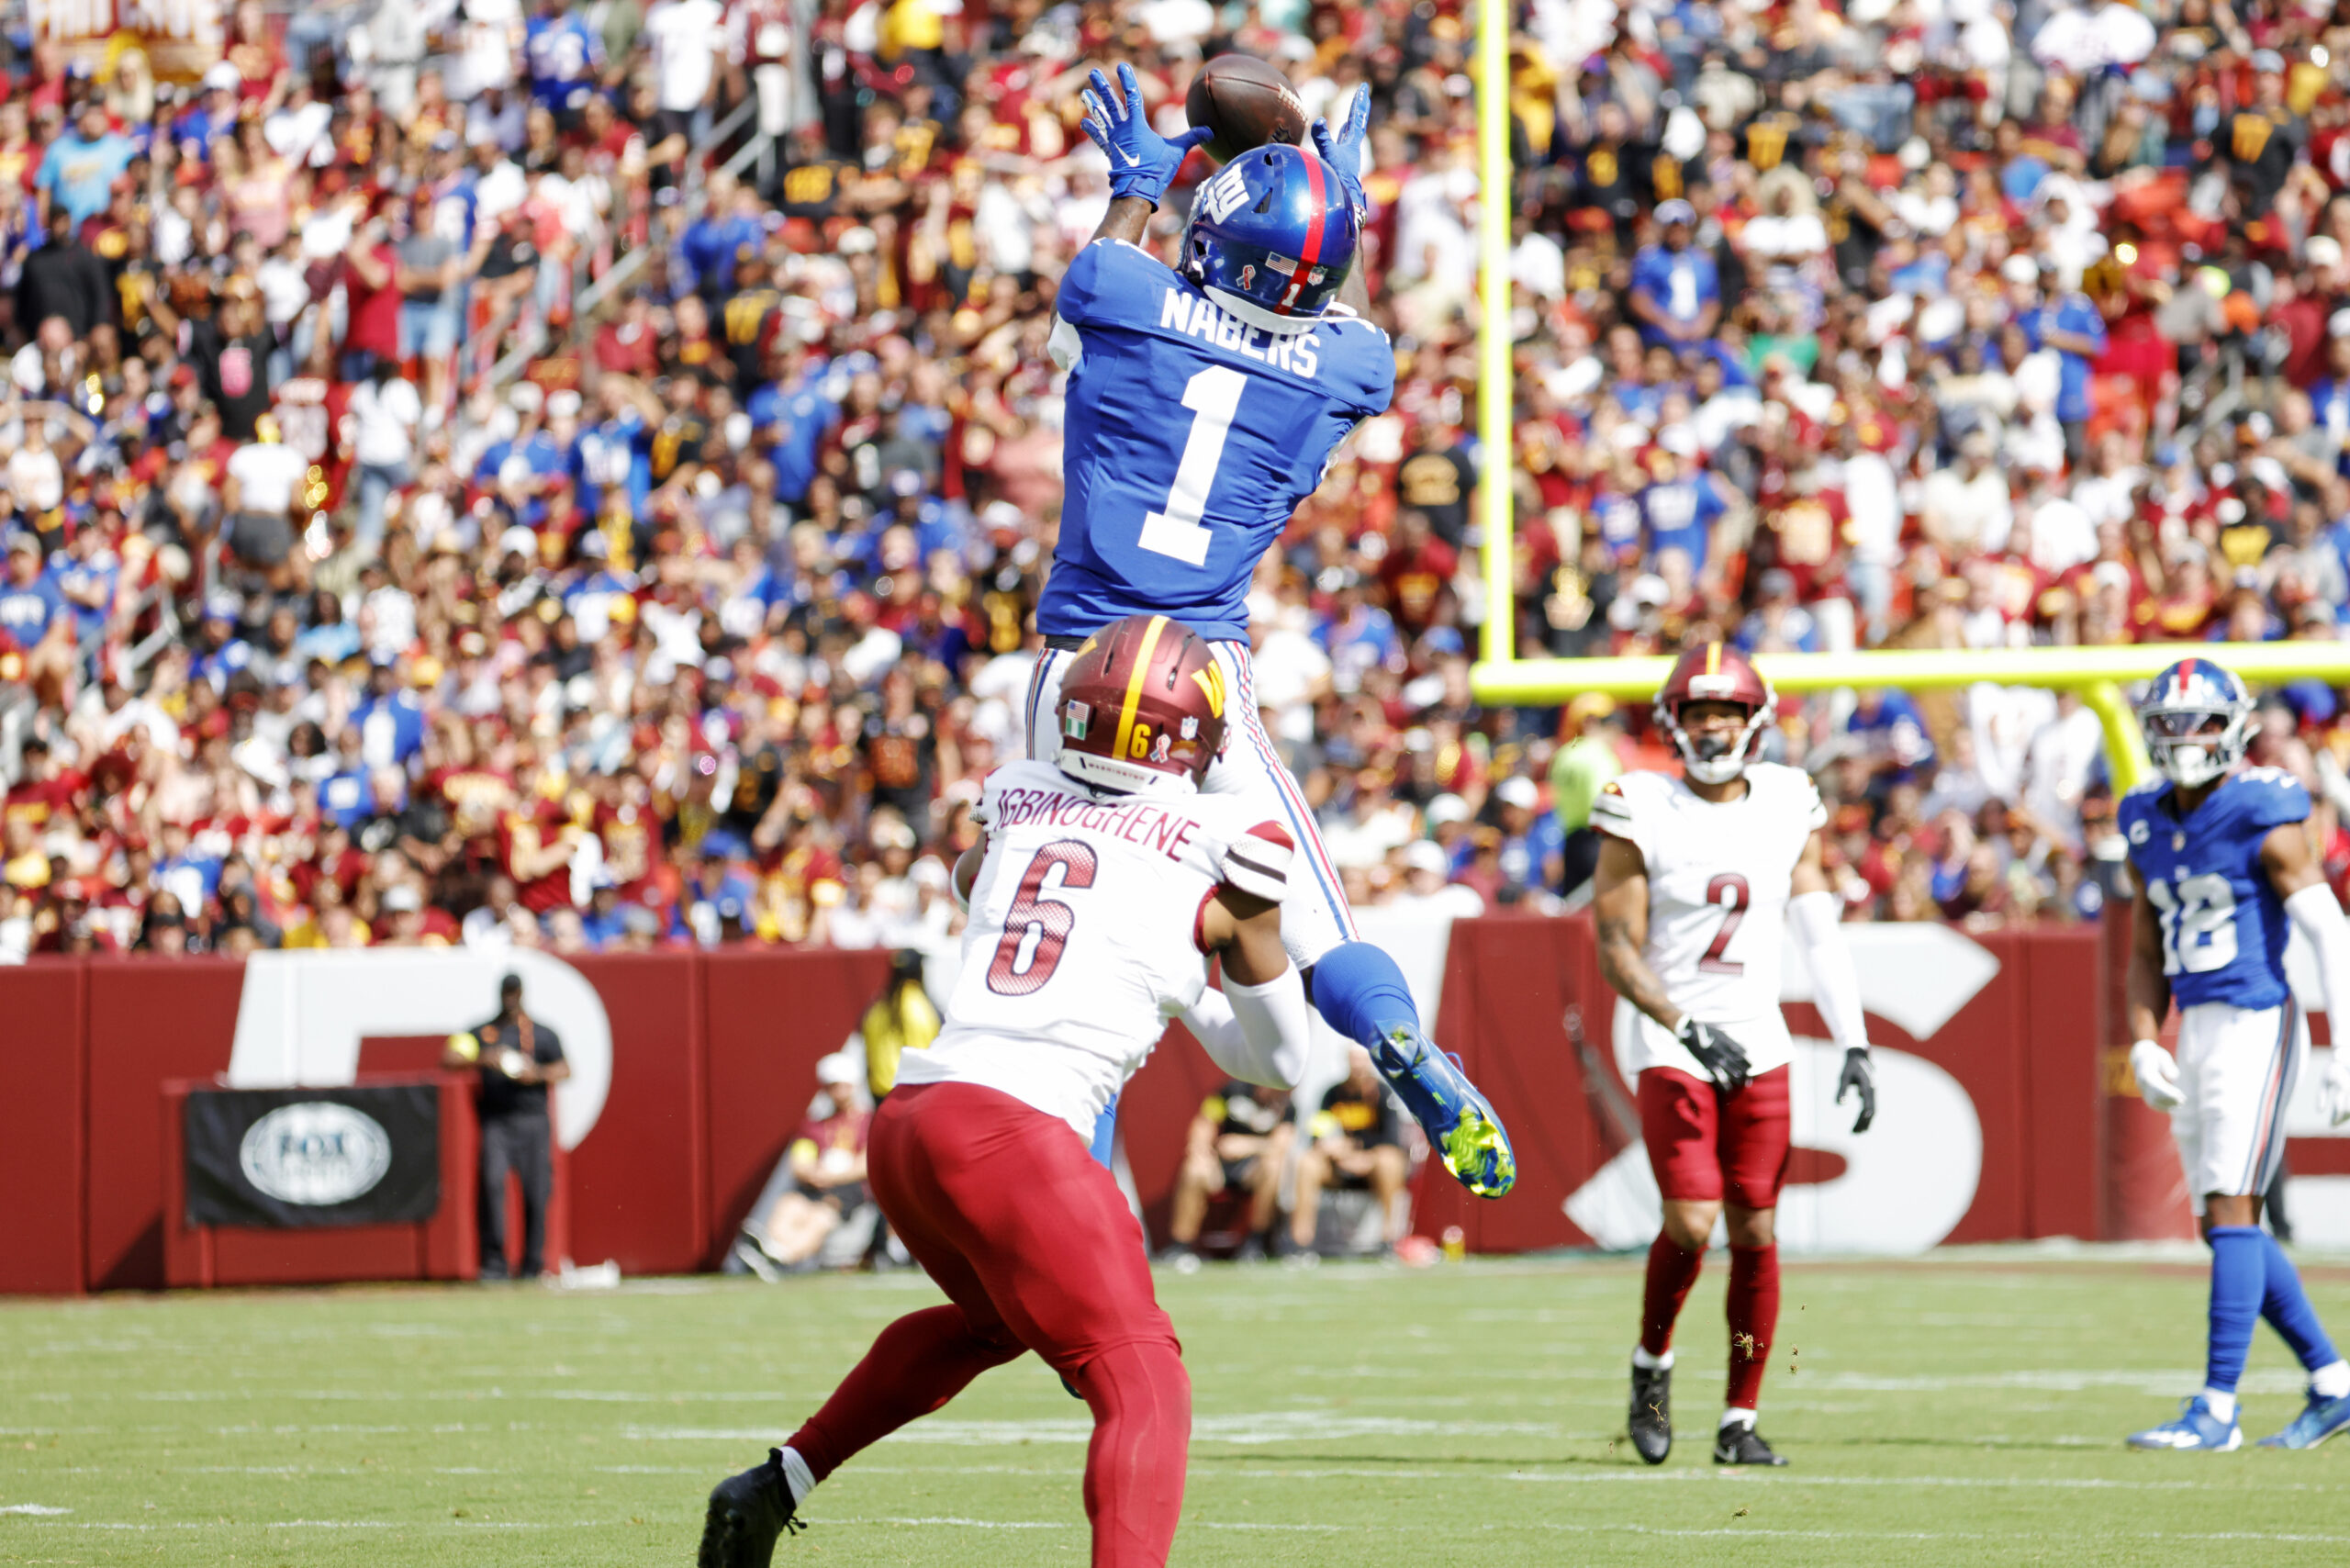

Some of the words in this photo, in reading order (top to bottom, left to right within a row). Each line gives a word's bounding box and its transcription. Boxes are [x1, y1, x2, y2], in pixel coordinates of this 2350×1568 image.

[1160, 287, 1320, 378] NABERS
[1281, 283, 1302, 307] 1
[1137, 364, 1248, 566] 1
[1130, 723, 1151, 758] 6
[994, 788, 1201, 863] IGBINOGHENE
[986, 838, 1098, 996] 6
[1696, 872, 1750, 977] 2
[2147, 873, 2238, 976] 18
